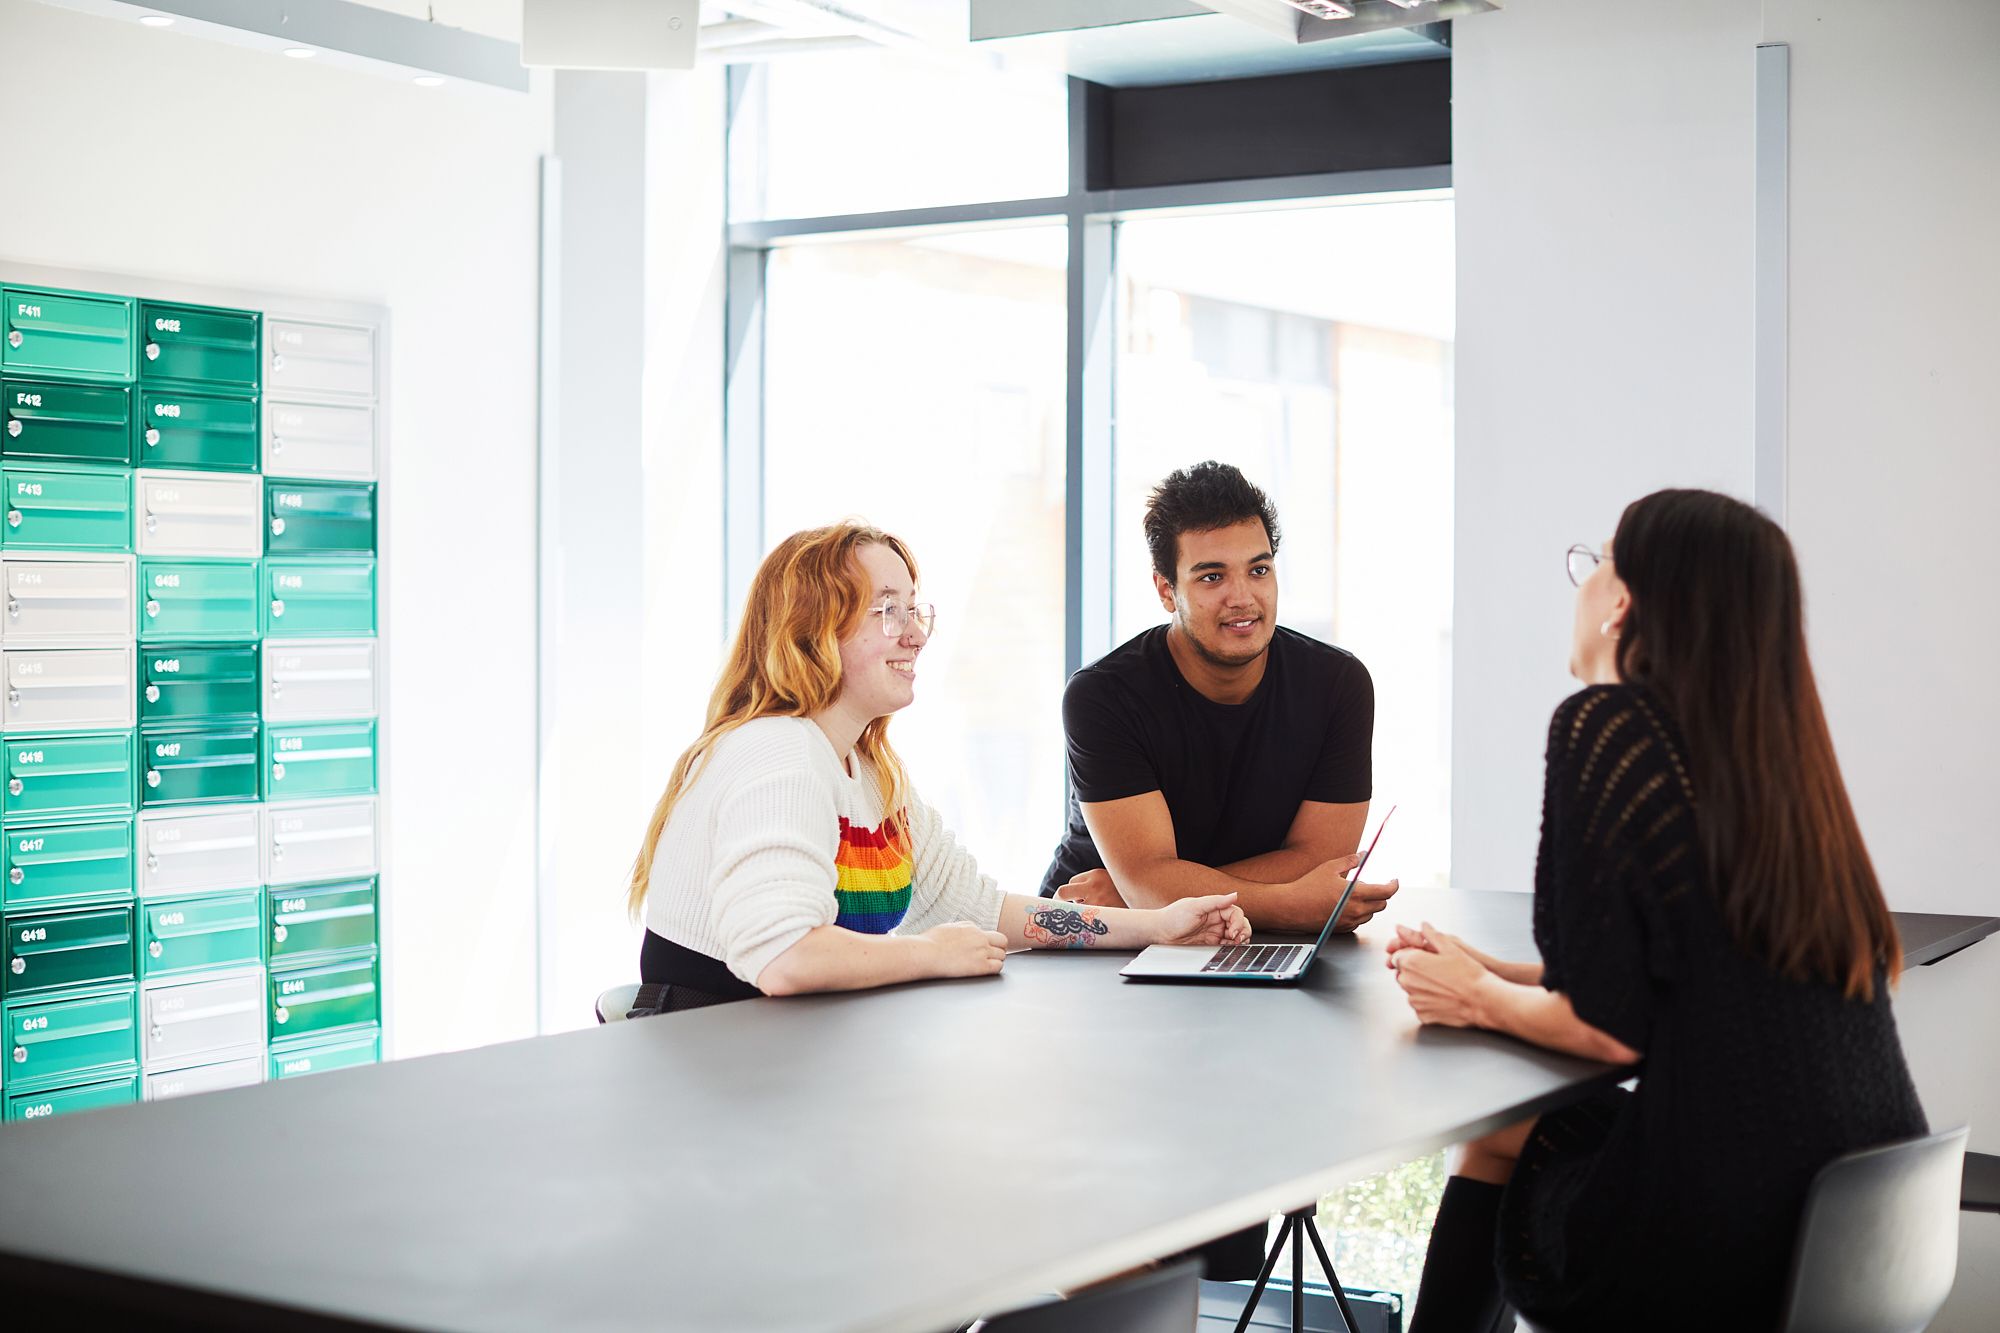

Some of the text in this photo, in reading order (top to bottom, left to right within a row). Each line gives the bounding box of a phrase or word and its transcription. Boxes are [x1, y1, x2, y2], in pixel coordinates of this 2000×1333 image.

[18, 304, 41, 318] F411
[155, 319, 181, 332] G422
[17, 393, 42, 407] F412
[18, 483, 42, 496] F413
[18, 573, 42, 585] F414
[18, 663, 42, 675] G415
[156, 743, 180, 757] G427
[20, 838, 44, 851] G417
[25, 1103, 52, 1119] G420
